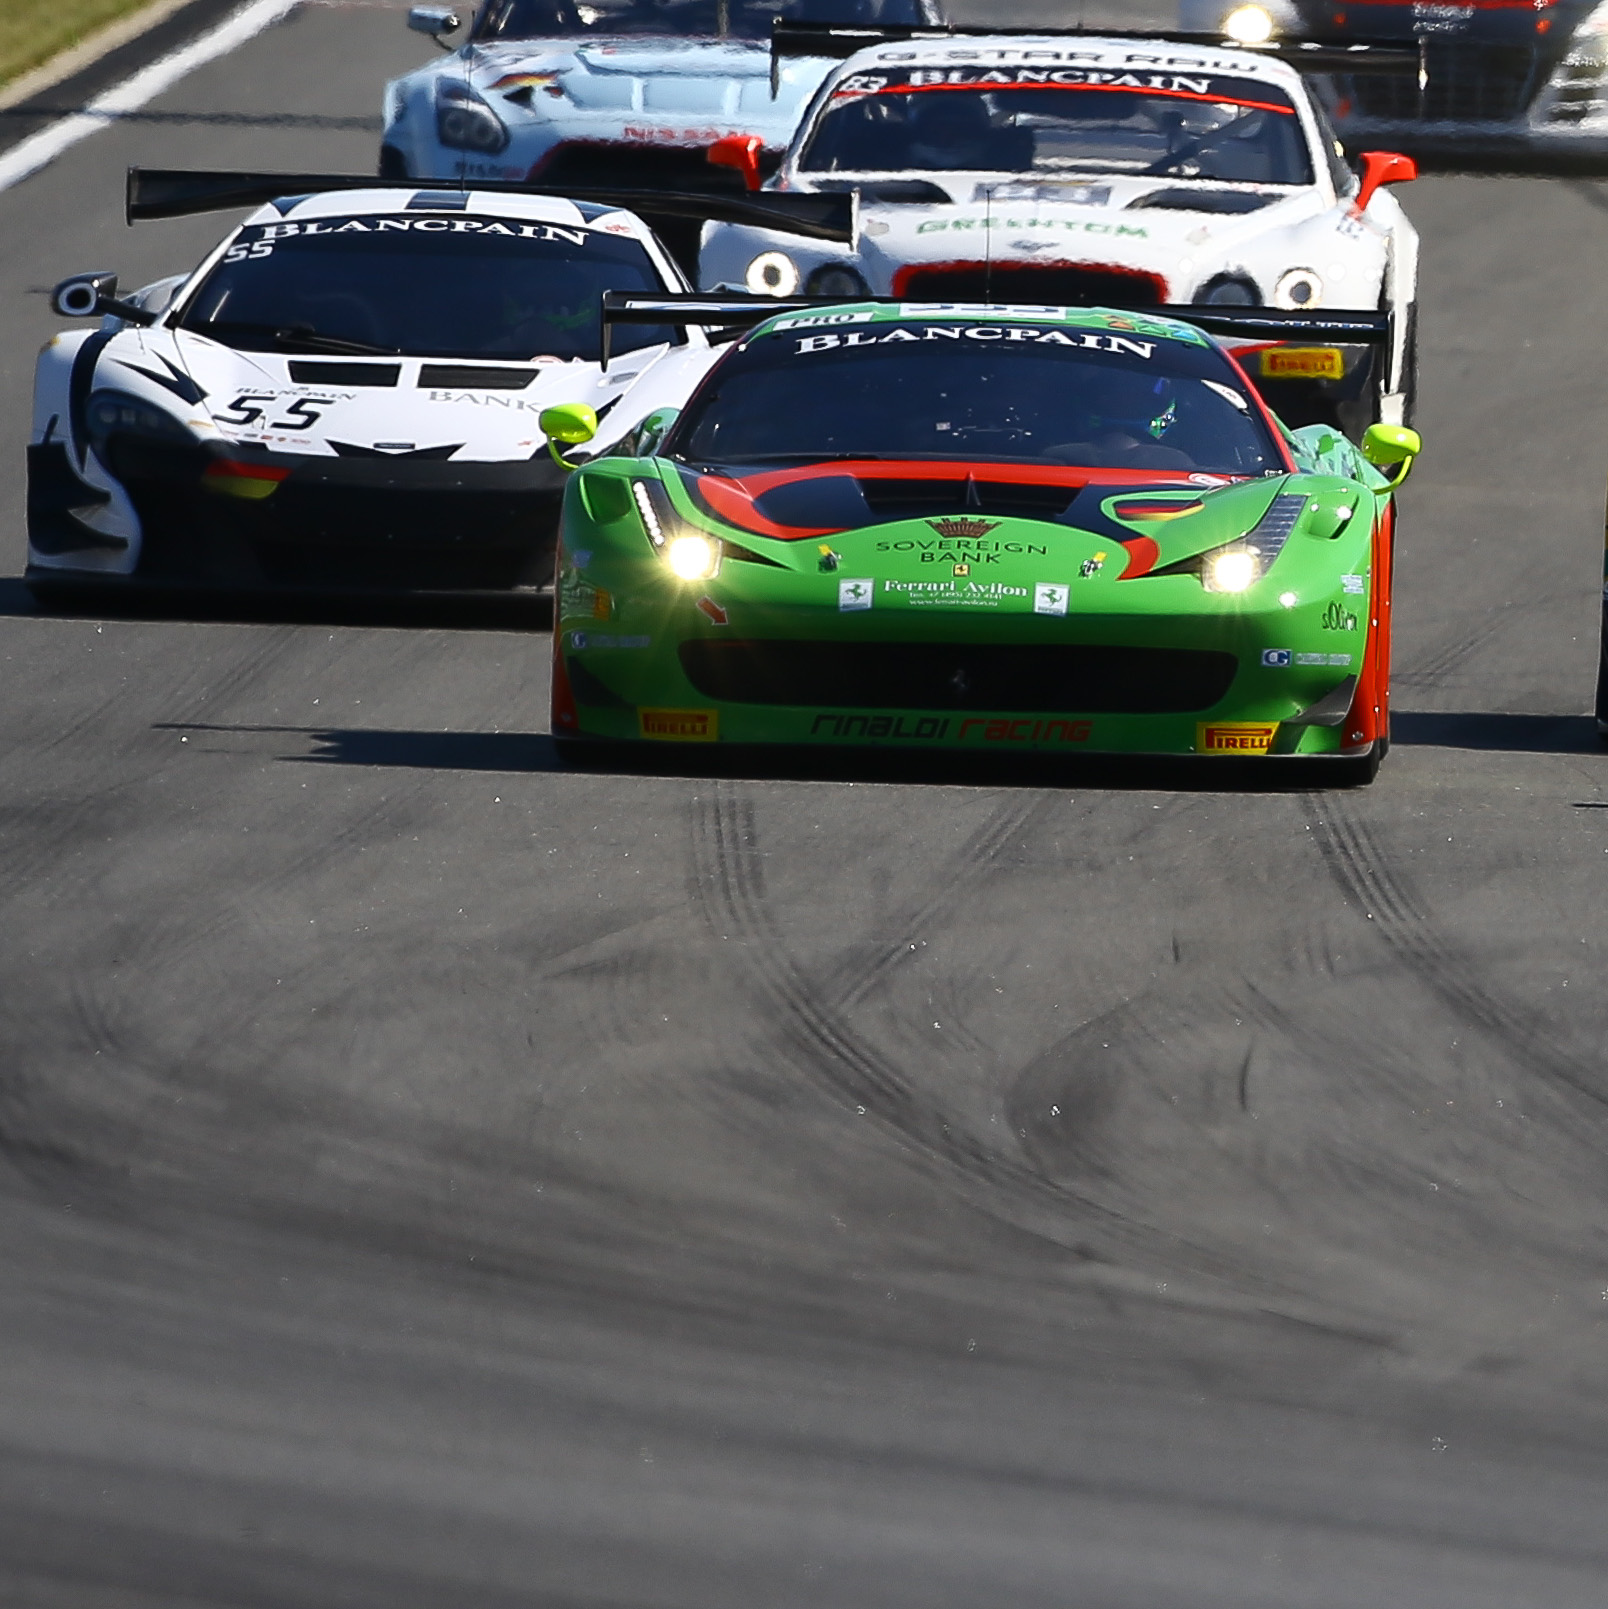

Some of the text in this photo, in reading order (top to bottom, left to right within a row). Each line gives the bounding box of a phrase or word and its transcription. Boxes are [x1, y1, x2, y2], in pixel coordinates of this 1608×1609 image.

[908, 69, 1212, 94] BLANCPAIN
[260, 218, 590, 246] BLANCPAIN
[224, 239, 275, 264] 55
[794, 326, 1158, 360] BLANCPAIN
[212, 395, 336, 430] 55
[876, 540, 1047, 555] SOVEREIGN
[920, 552, 1001, 564] BANK
[884, 580, 1028, 597] Ferrari Avilon
[641, 712, 709, 736] PIRELLI
